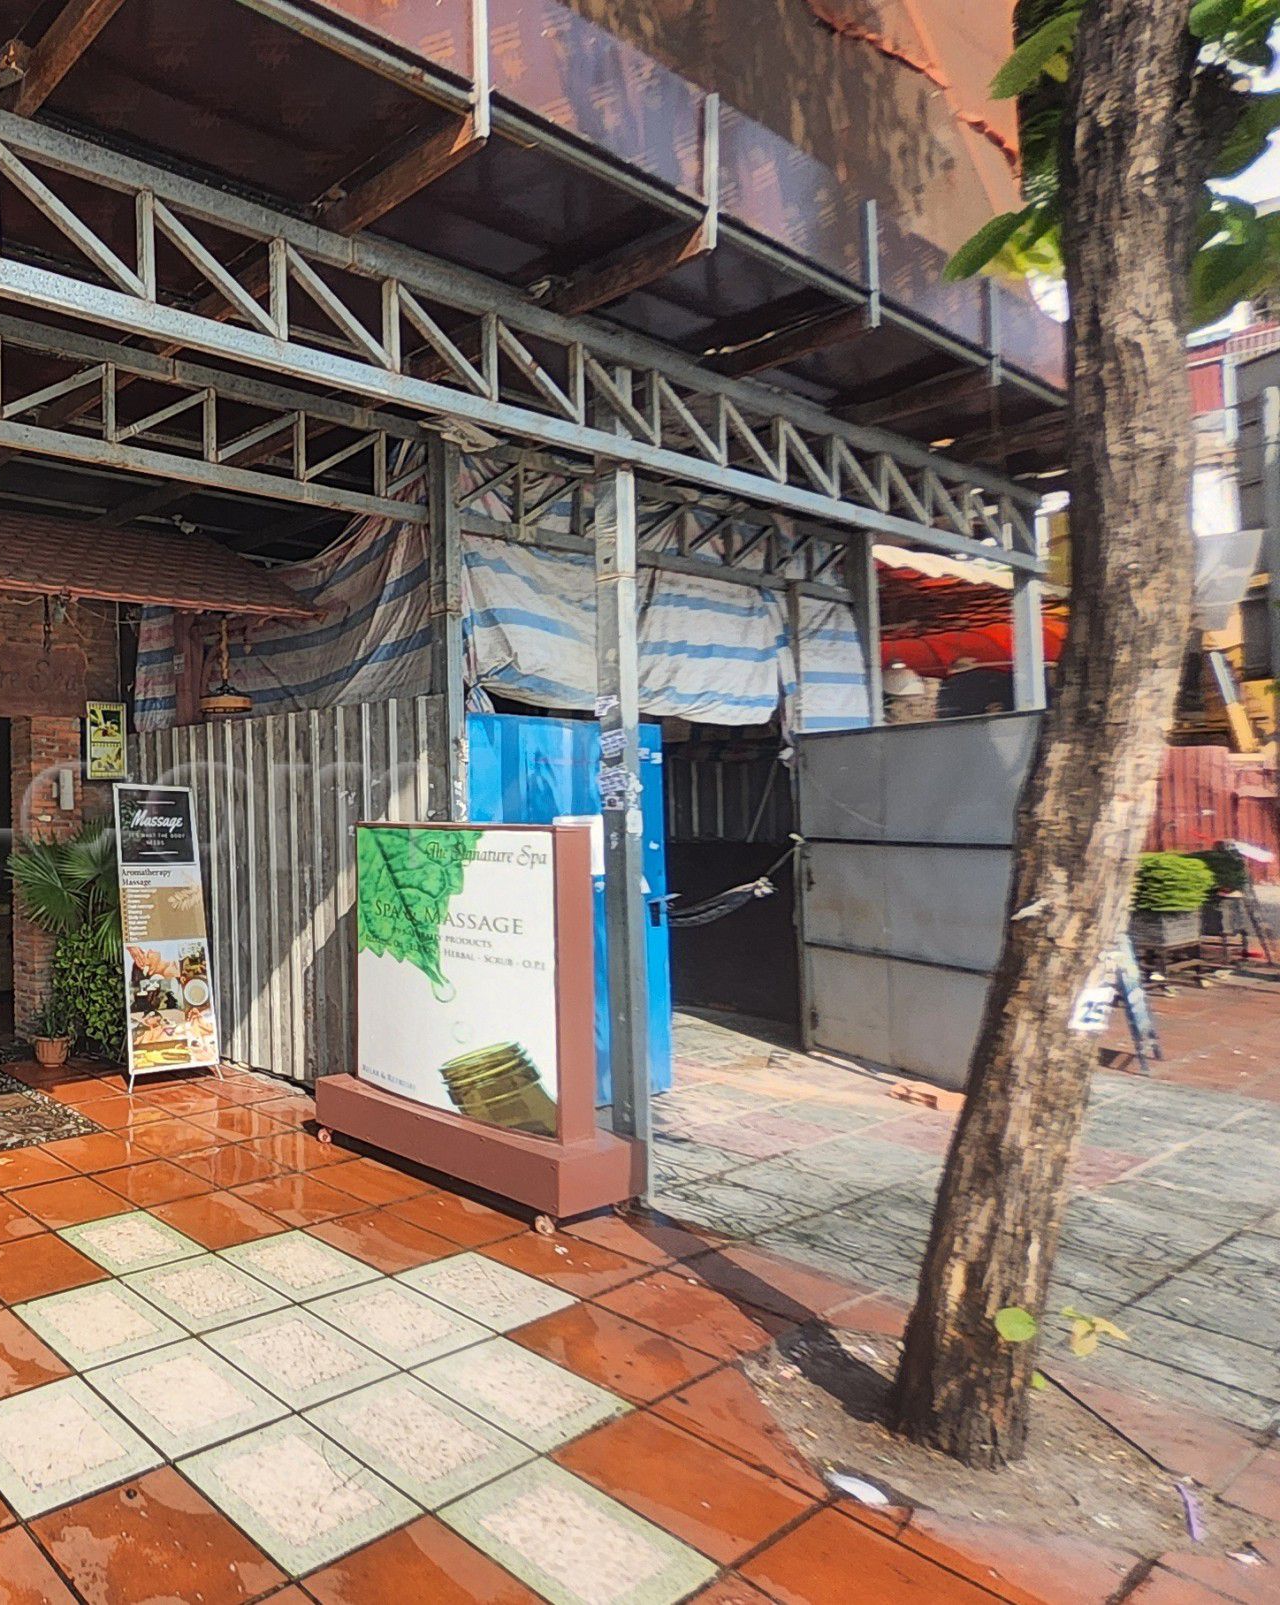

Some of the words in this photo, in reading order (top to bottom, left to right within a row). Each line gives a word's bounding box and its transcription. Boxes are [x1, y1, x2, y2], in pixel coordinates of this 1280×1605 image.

[130, 809, 183, 833] Massage
[516, 845, 548, 869] Spa
[121, 868, 172, 878] Aromatherapy
[121, 878, 152, 886] Massage
[424, 900, 524, 935] MASSAGE
